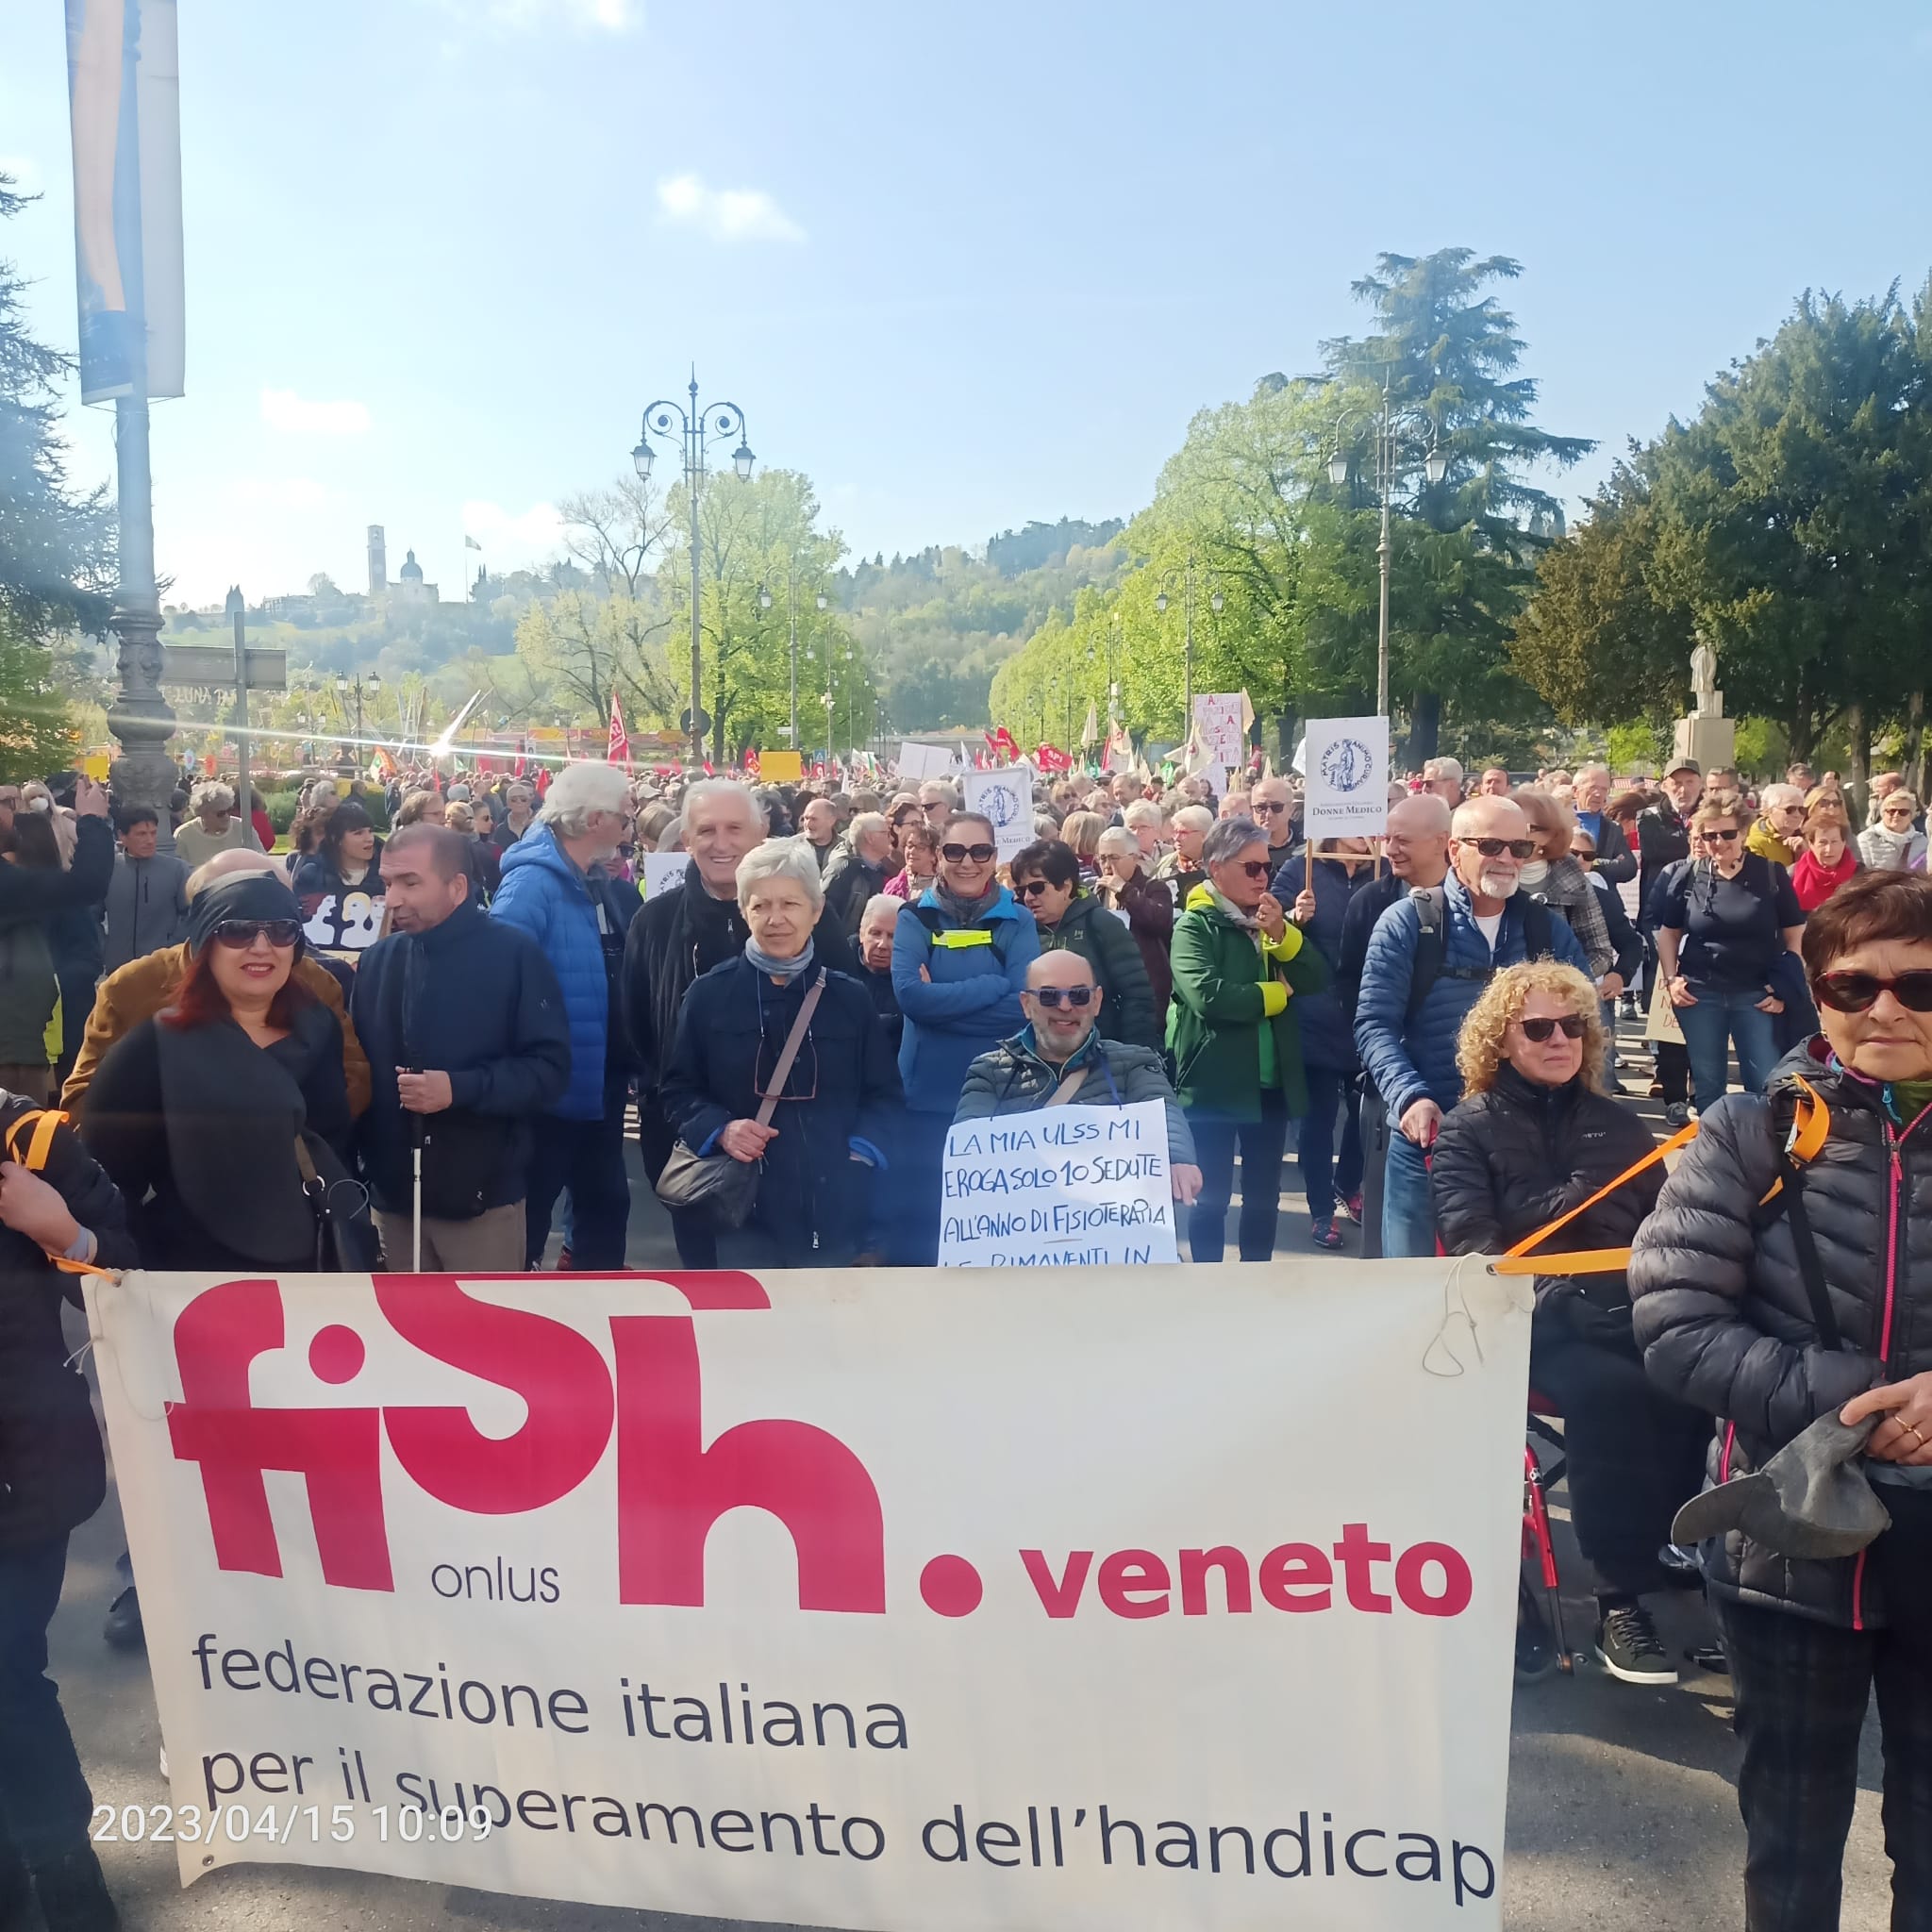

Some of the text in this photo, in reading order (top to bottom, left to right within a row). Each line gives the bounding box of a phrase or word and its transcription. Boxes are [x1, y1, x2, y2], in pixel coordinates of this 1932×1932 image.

[1312, 805, 1382, 816] DONNE MEDICO
[949, 1119, 1140, 1158] LA MIA ULSS MI
[944, 1153, 1163, 1198] EROGA SOLO 10 SEDUTE
[943, 1198, 1167, 1243] ALL'ANNO DI FISIOTERAPIA
[1124, 1245, 1151, 1265] IN
[430, 1556, 561, 1604] onlus
[1019, 1523, 1473, 1619] veneto
[192, 1632, 908, 1751] federazione italiana
[201, 1750, 313, 1812] per
[339, 1746, 372, 1804] il
[395, 1771, 886, 1862] superamento
